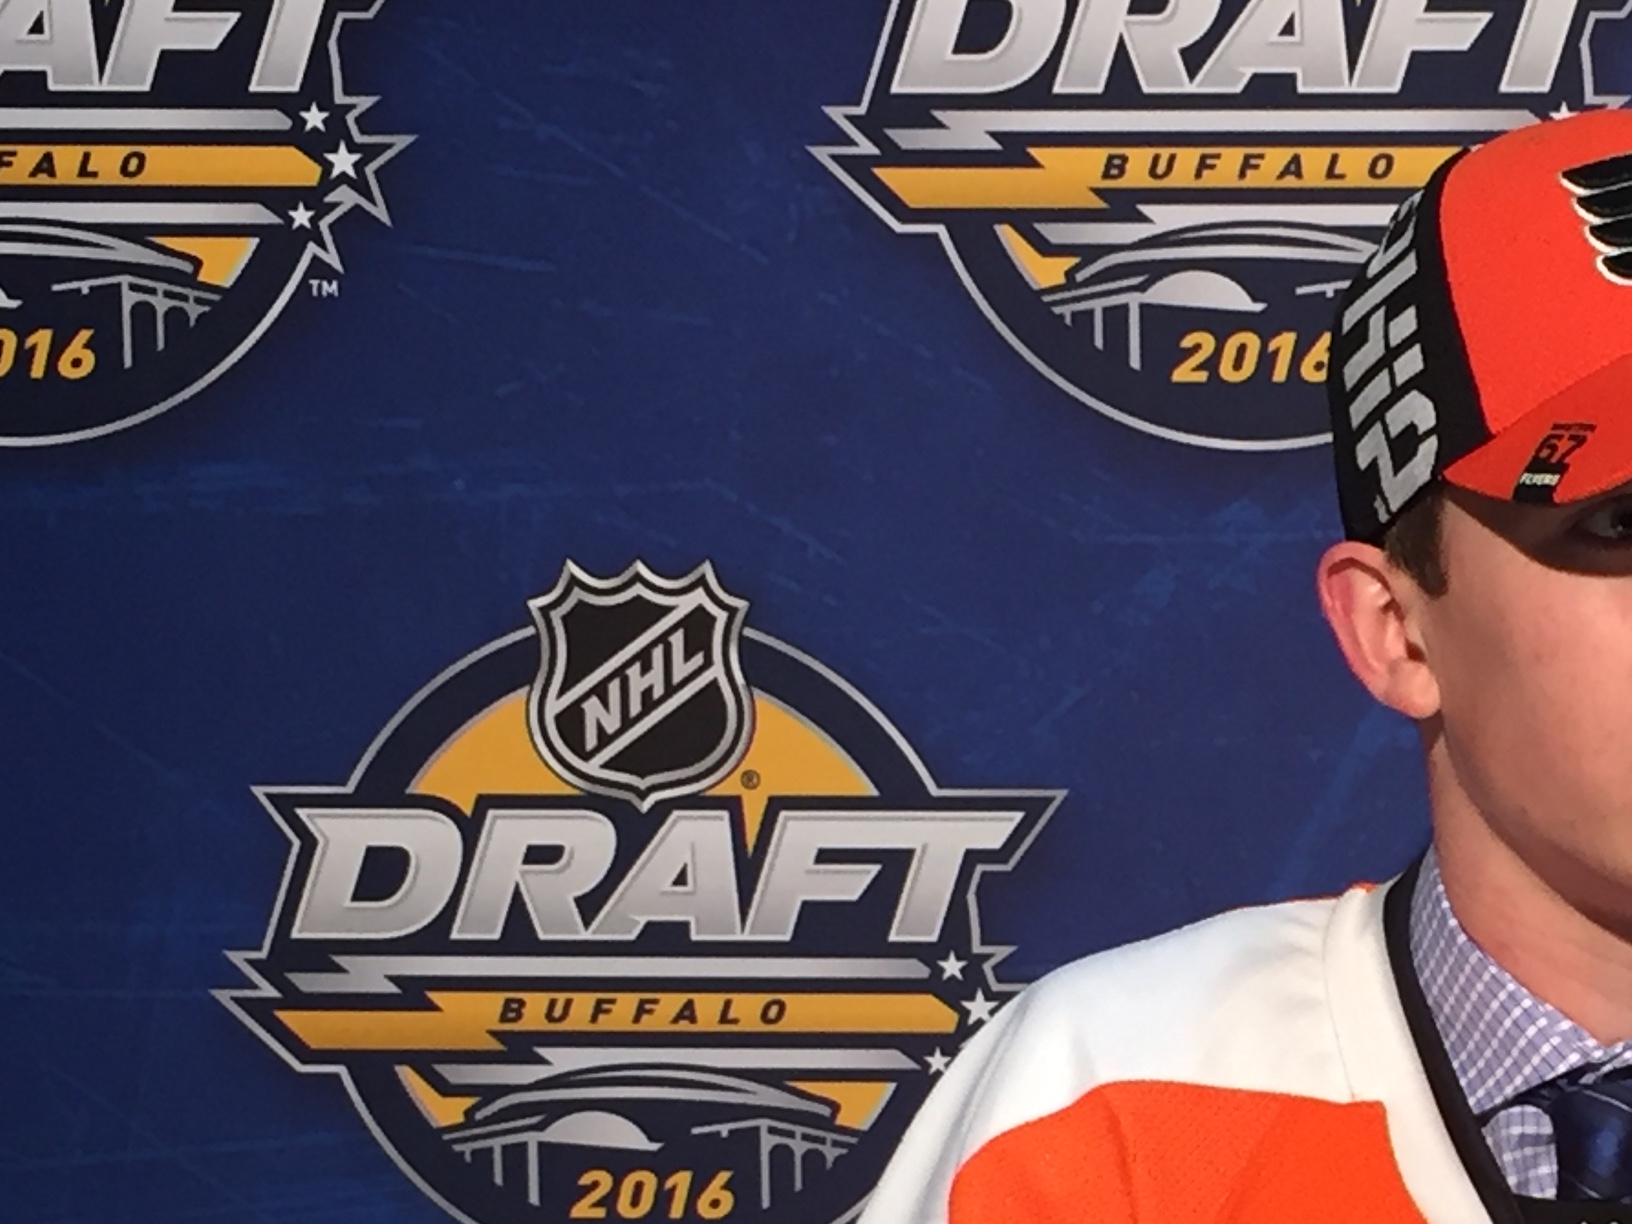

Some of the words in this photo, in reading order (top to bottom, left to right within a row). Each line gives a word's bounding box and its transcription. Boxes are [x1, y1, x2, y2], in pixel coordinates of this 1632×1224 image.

[890, 0, 1570, 94] DRAFT
[1101, 152, 1395, 181] BUFFALO
[310, 280, 339, 297] TM
[1171, 331, 1332, 383] 2016
[578, 629, 705, 752] NHL
[291, 808, 1025, 942] DRAFT
[499, 998, 787, 1026] BUFFALO
[570, 1169, 735, 1220] 2016
